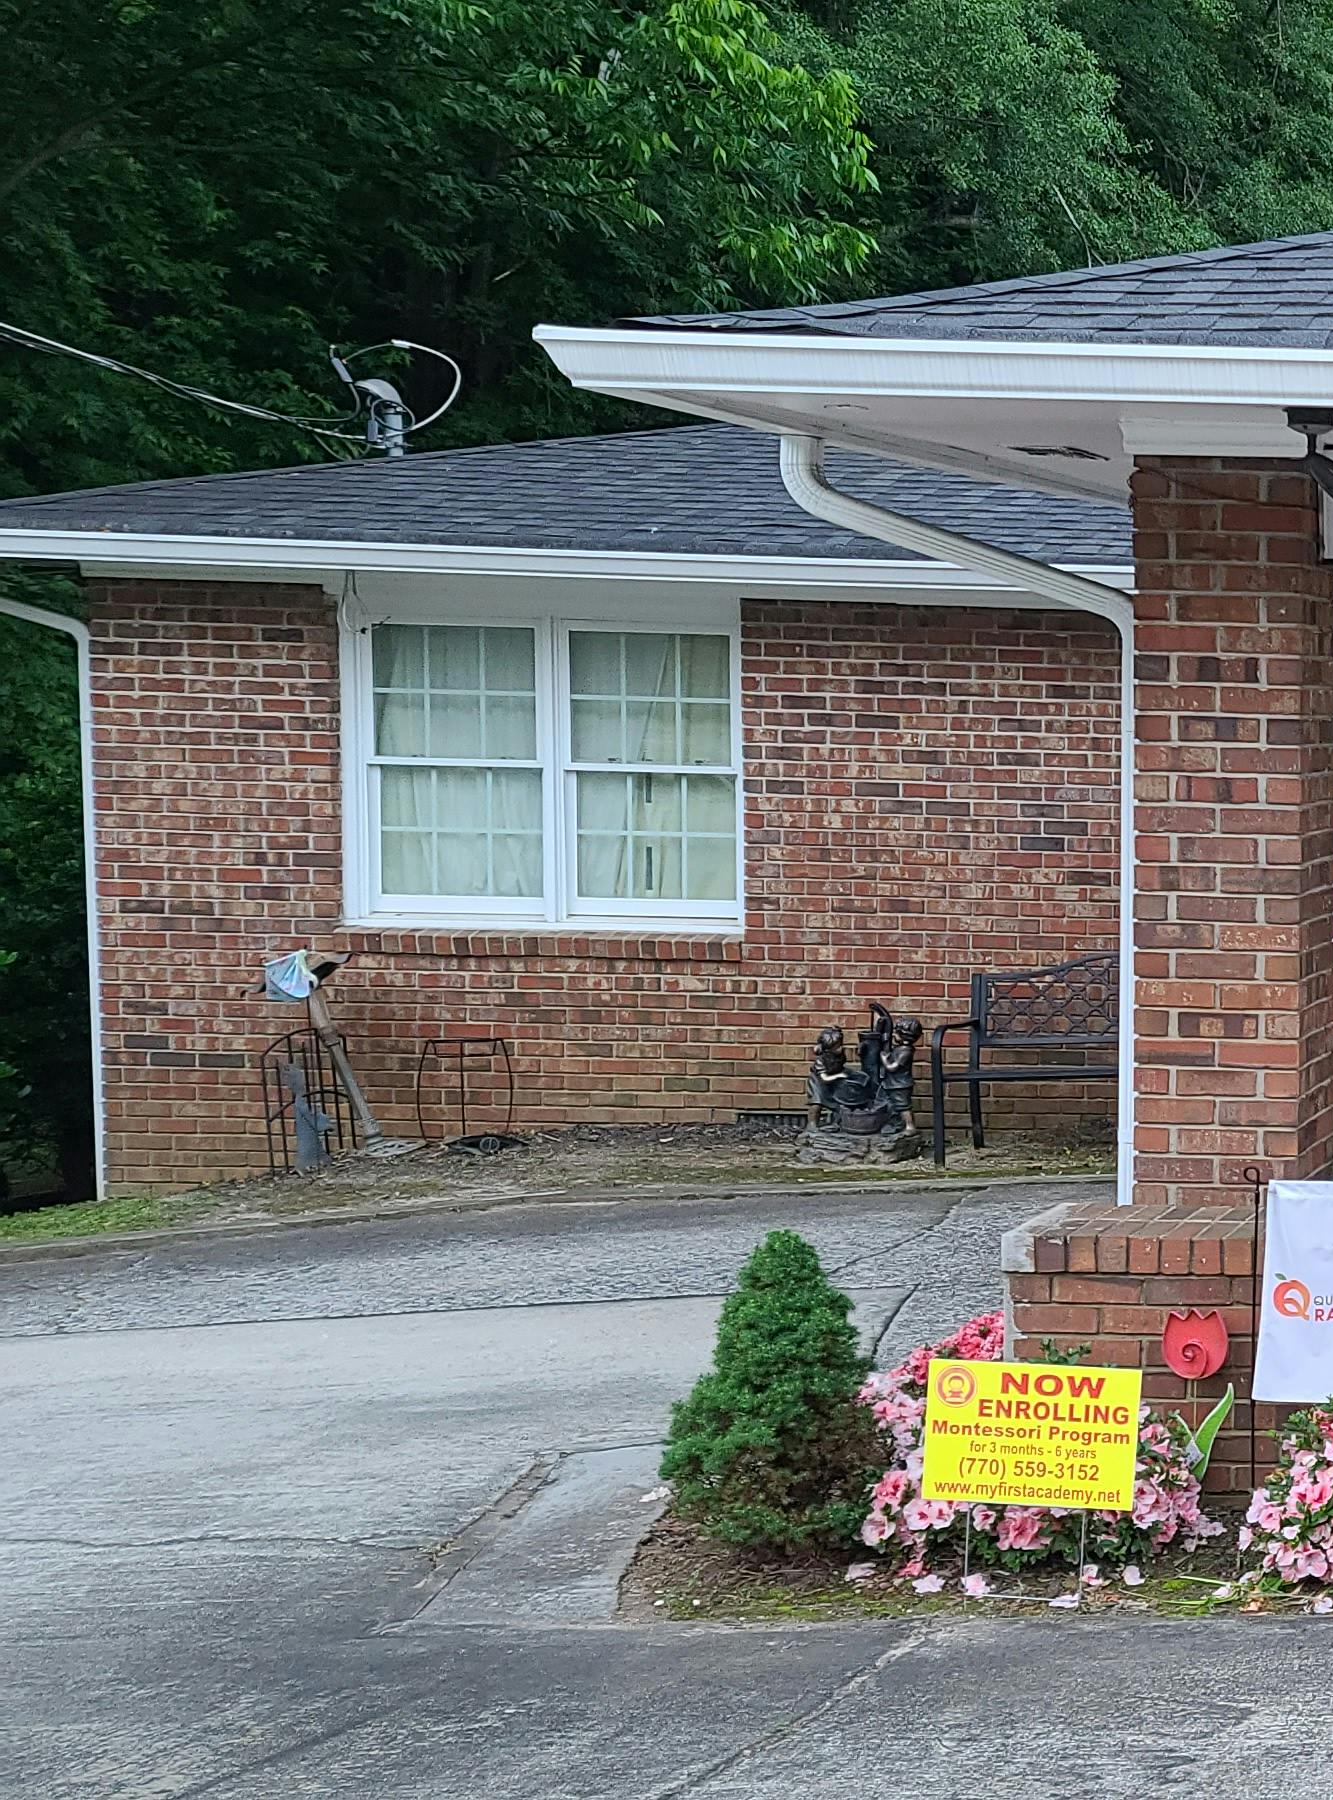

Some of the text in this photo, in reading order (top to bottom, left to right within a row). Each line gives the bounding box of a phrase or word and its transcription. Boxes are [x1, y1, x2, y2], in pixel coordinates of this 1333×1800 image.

[1000, 1372, 1106, 1399] NOW
[978, 1399, 1130, 1425] ENROLLING
[932, 1419, 1130, 1446] Montessori Program
[969, 1441, 987, 1453] for
[989, 1442, 997, 1454] 3
[1000, 1442, 1044, 1456] months
[1055, 1446, 1062, 1457] 6
[1065, 1447, 1097, 1461] years
[959, 1456, 1100, 1481] (770) 559-3152
[934, 1480, 1121, 1504] www.myfirstacademy.net
